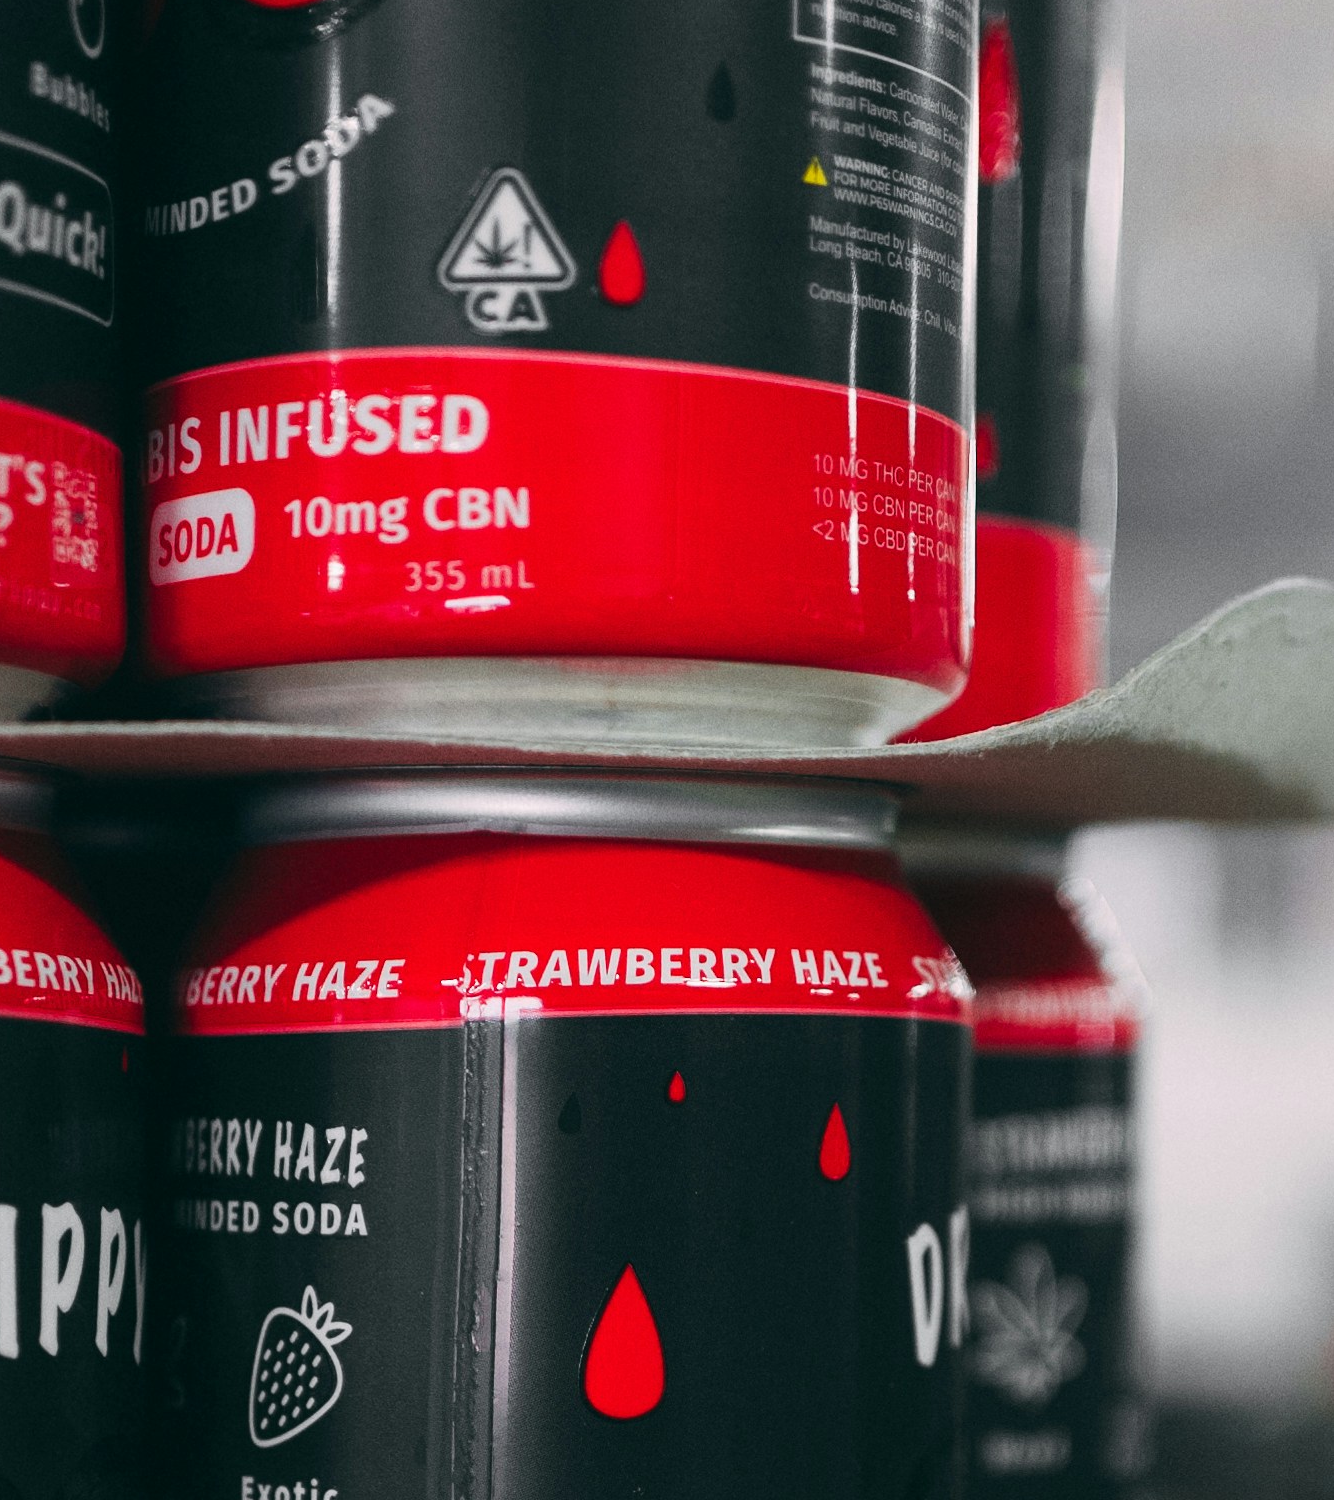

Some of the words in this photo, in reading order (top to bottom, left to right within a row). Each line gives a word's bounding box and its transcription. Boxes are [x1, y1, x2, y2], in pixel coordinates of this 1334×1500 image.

[30, 62, 111, 133] Bubbles
[268, 94, 397, 196] SODA
[472, 289, 544, 325] CA
[219, 393, 490, 466] INFUSED
[813, 453, 834, 475] 10
[873, 461, 903, 487] THC
[908, 467, 936, 494] PER
[157, 513, 240, 567] SODA
[284, 496, 409, 546] 10mg
[423, 487, 532, 533] CBN
[813, 486, 834, 511] 10
[873, 496, 903, 521] CBN
[908, 502, 936, 528] PER
[873, 528, 905, 553] CBD
[405, 561, 466, 593] 355
[479, 563, 535, 591] mL
[290, 959, 406, 1003] HAZE
[462, 947, 775, 992] STRAWBERRY
[791, 950, 888, 992] HAZE
[275, 1118, 368, 1189] HAZE
[271, 1201, 369, 1238] SODA
